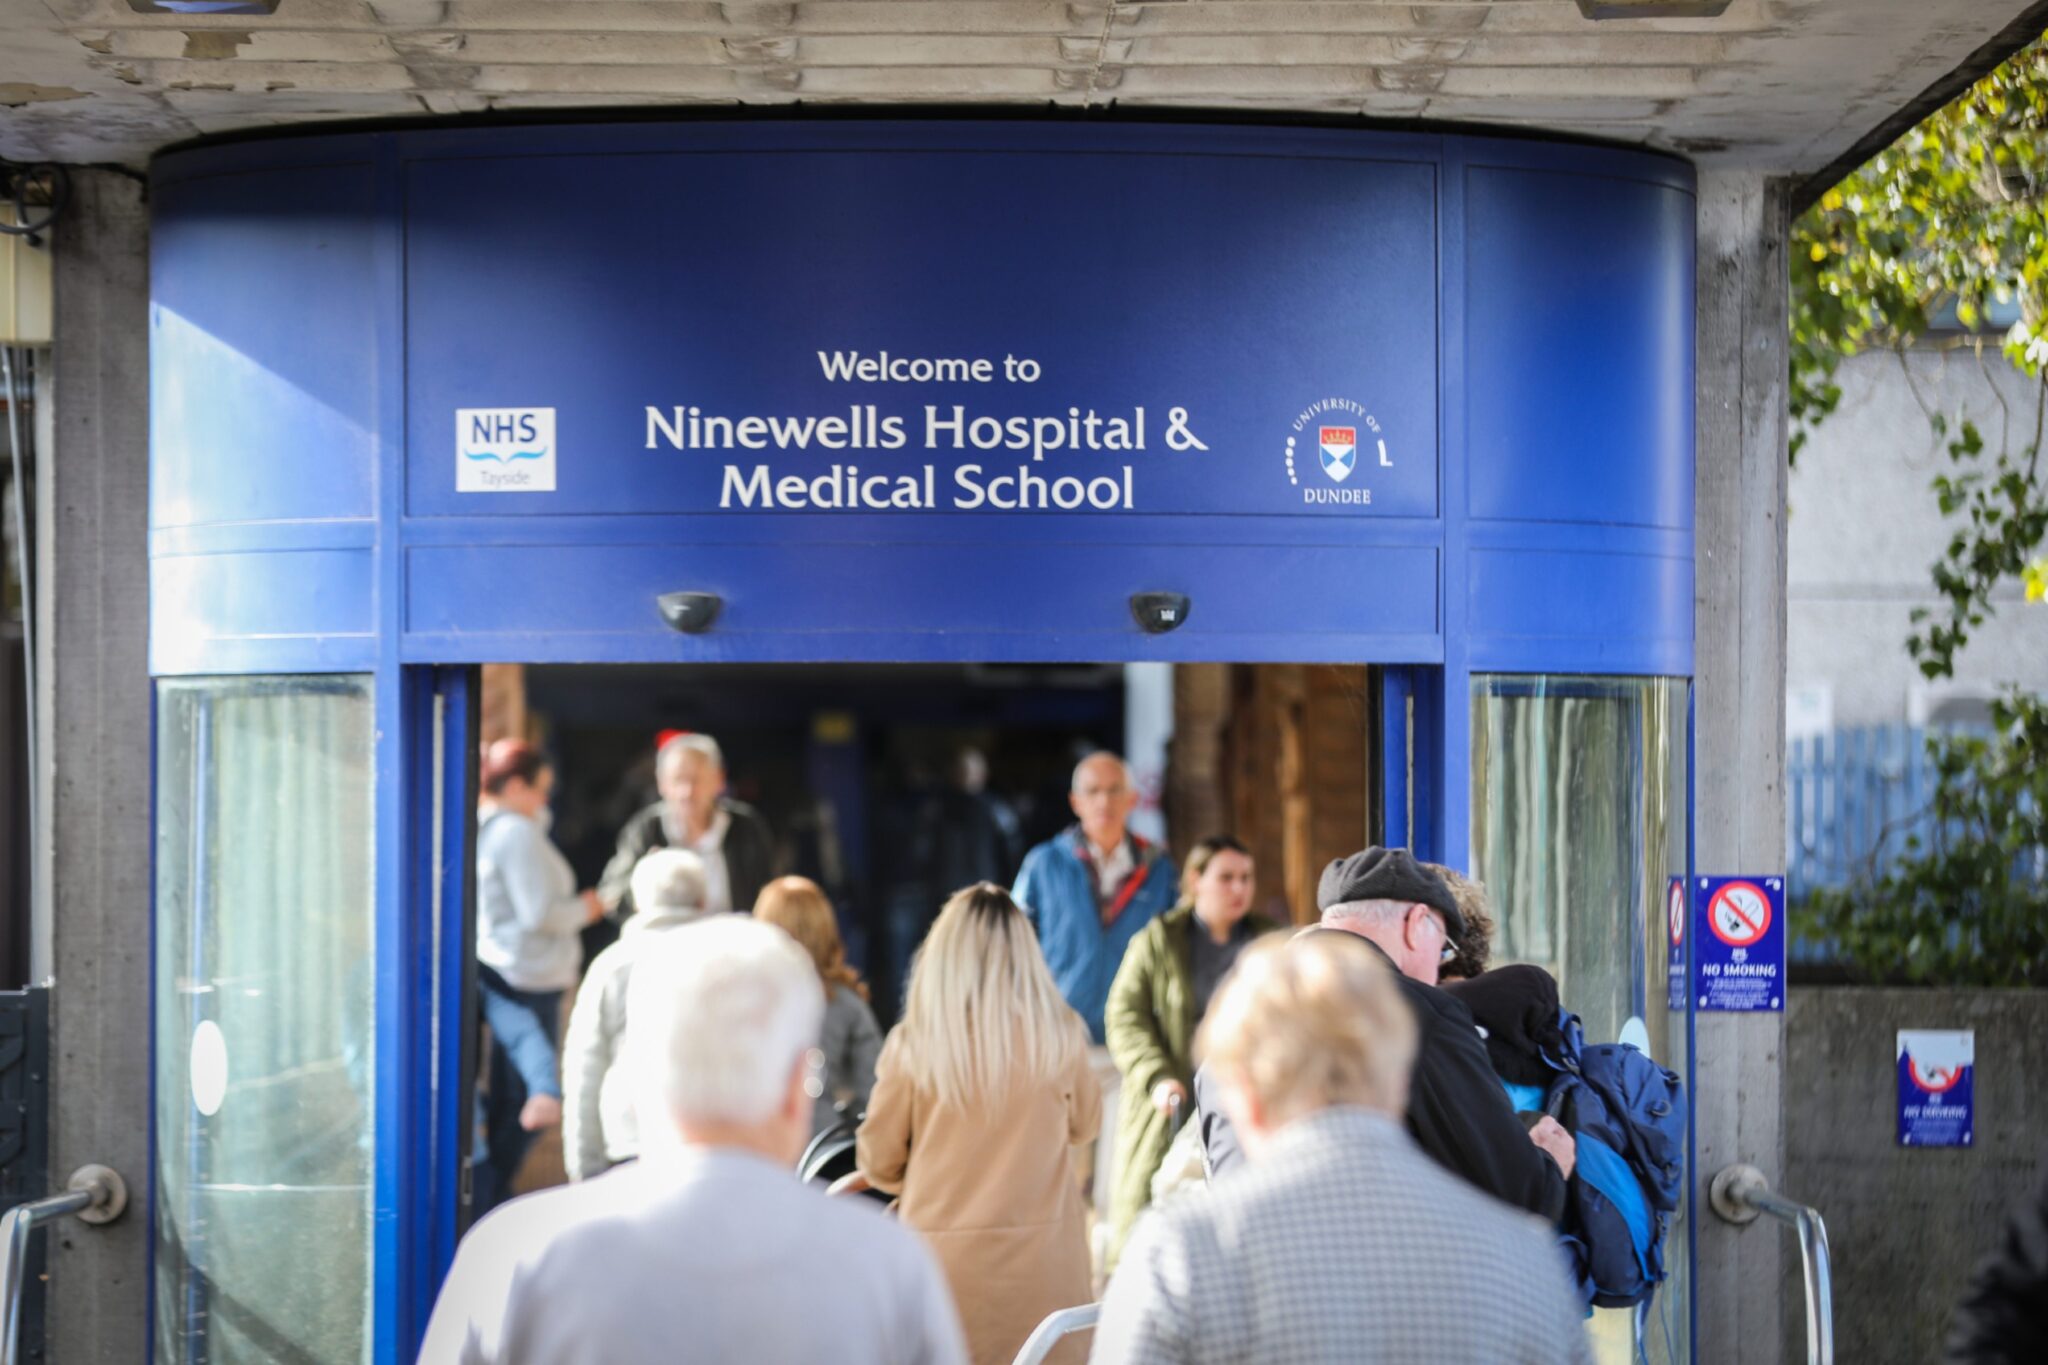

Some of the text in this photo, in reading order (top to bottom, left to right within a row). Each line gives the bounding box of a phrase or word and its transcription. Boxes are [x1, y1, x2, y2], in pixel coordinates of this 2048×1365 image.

[817, 350, 1042, 382] Welcome to
[472, 413, 537, 443] NHS
[1292, 397, 1382, 434] UNIVERSITY OF
[644, 404, 1210, 461] Ninewells Hospital &
[480, 470, 531, 488] Tayside
[719, 463, 1135, 508] Medical School
[1303, 488, 1372, 504] DUNDEE
[1702, 963, 1721, 977] NO
[1723, 963, 1777, 978] SMOKING
